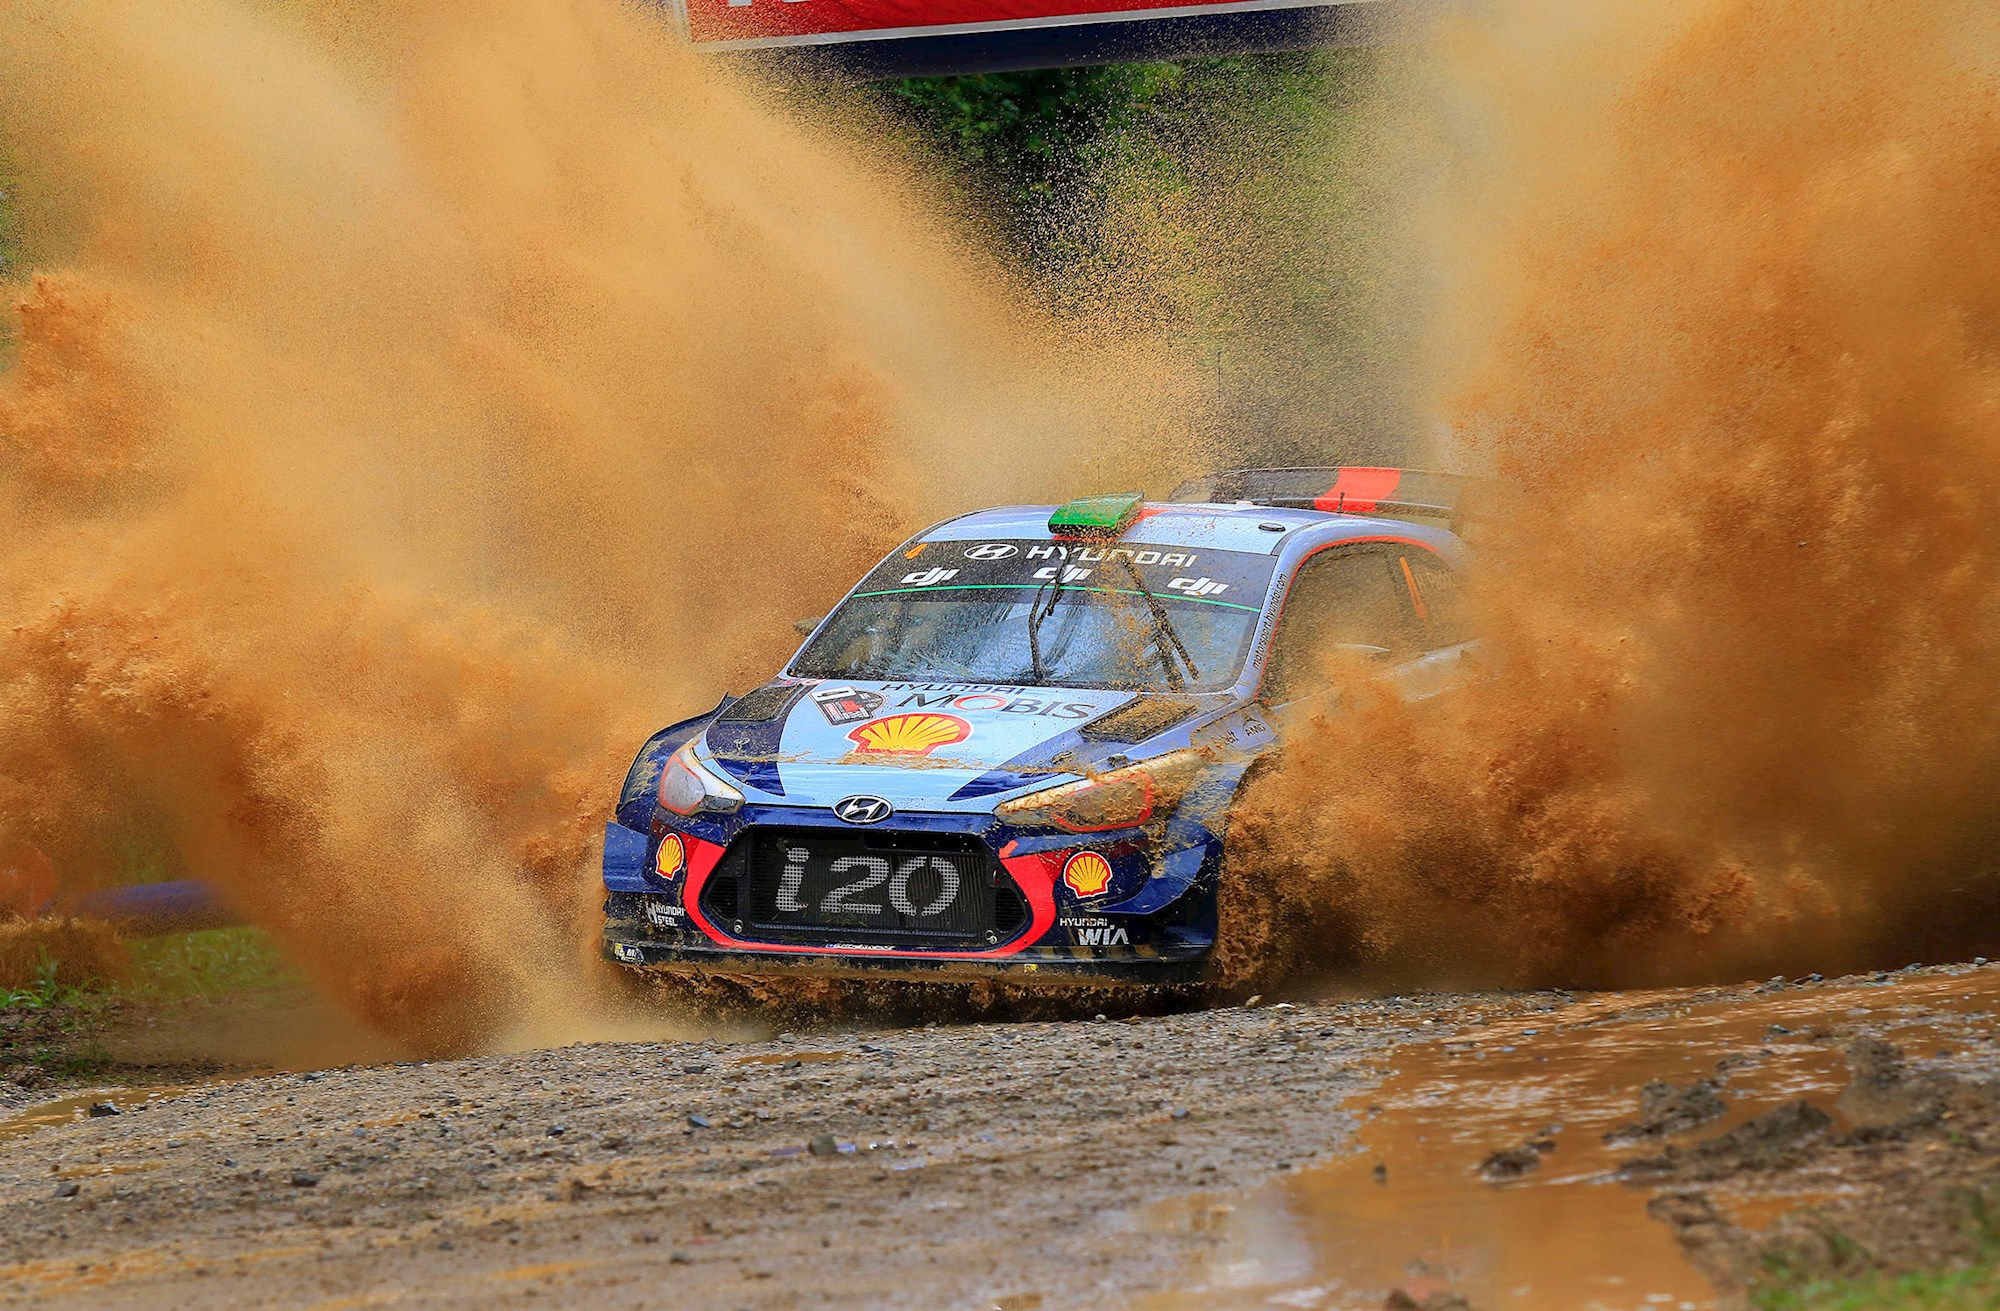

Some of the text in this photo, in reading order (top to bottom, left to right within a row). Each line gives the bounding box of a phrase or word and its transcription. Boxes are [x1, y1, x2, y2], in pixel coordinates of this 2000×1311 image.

[1025, 544, 1198, 568] HYUNDAI
[1252, 573, 1288, 670] motorsport.hyundai.com
[880, 682, 1025, 695] HYUNDAI
[896, 693, 1098, 720] MOBIS
[775, 847, 960, 917] i20
[655, 901, 686, 917] HYUNDAI
[656, 915, 679, 927] STEEL
[1059, 917, 1108, 927] HYUNDAI
